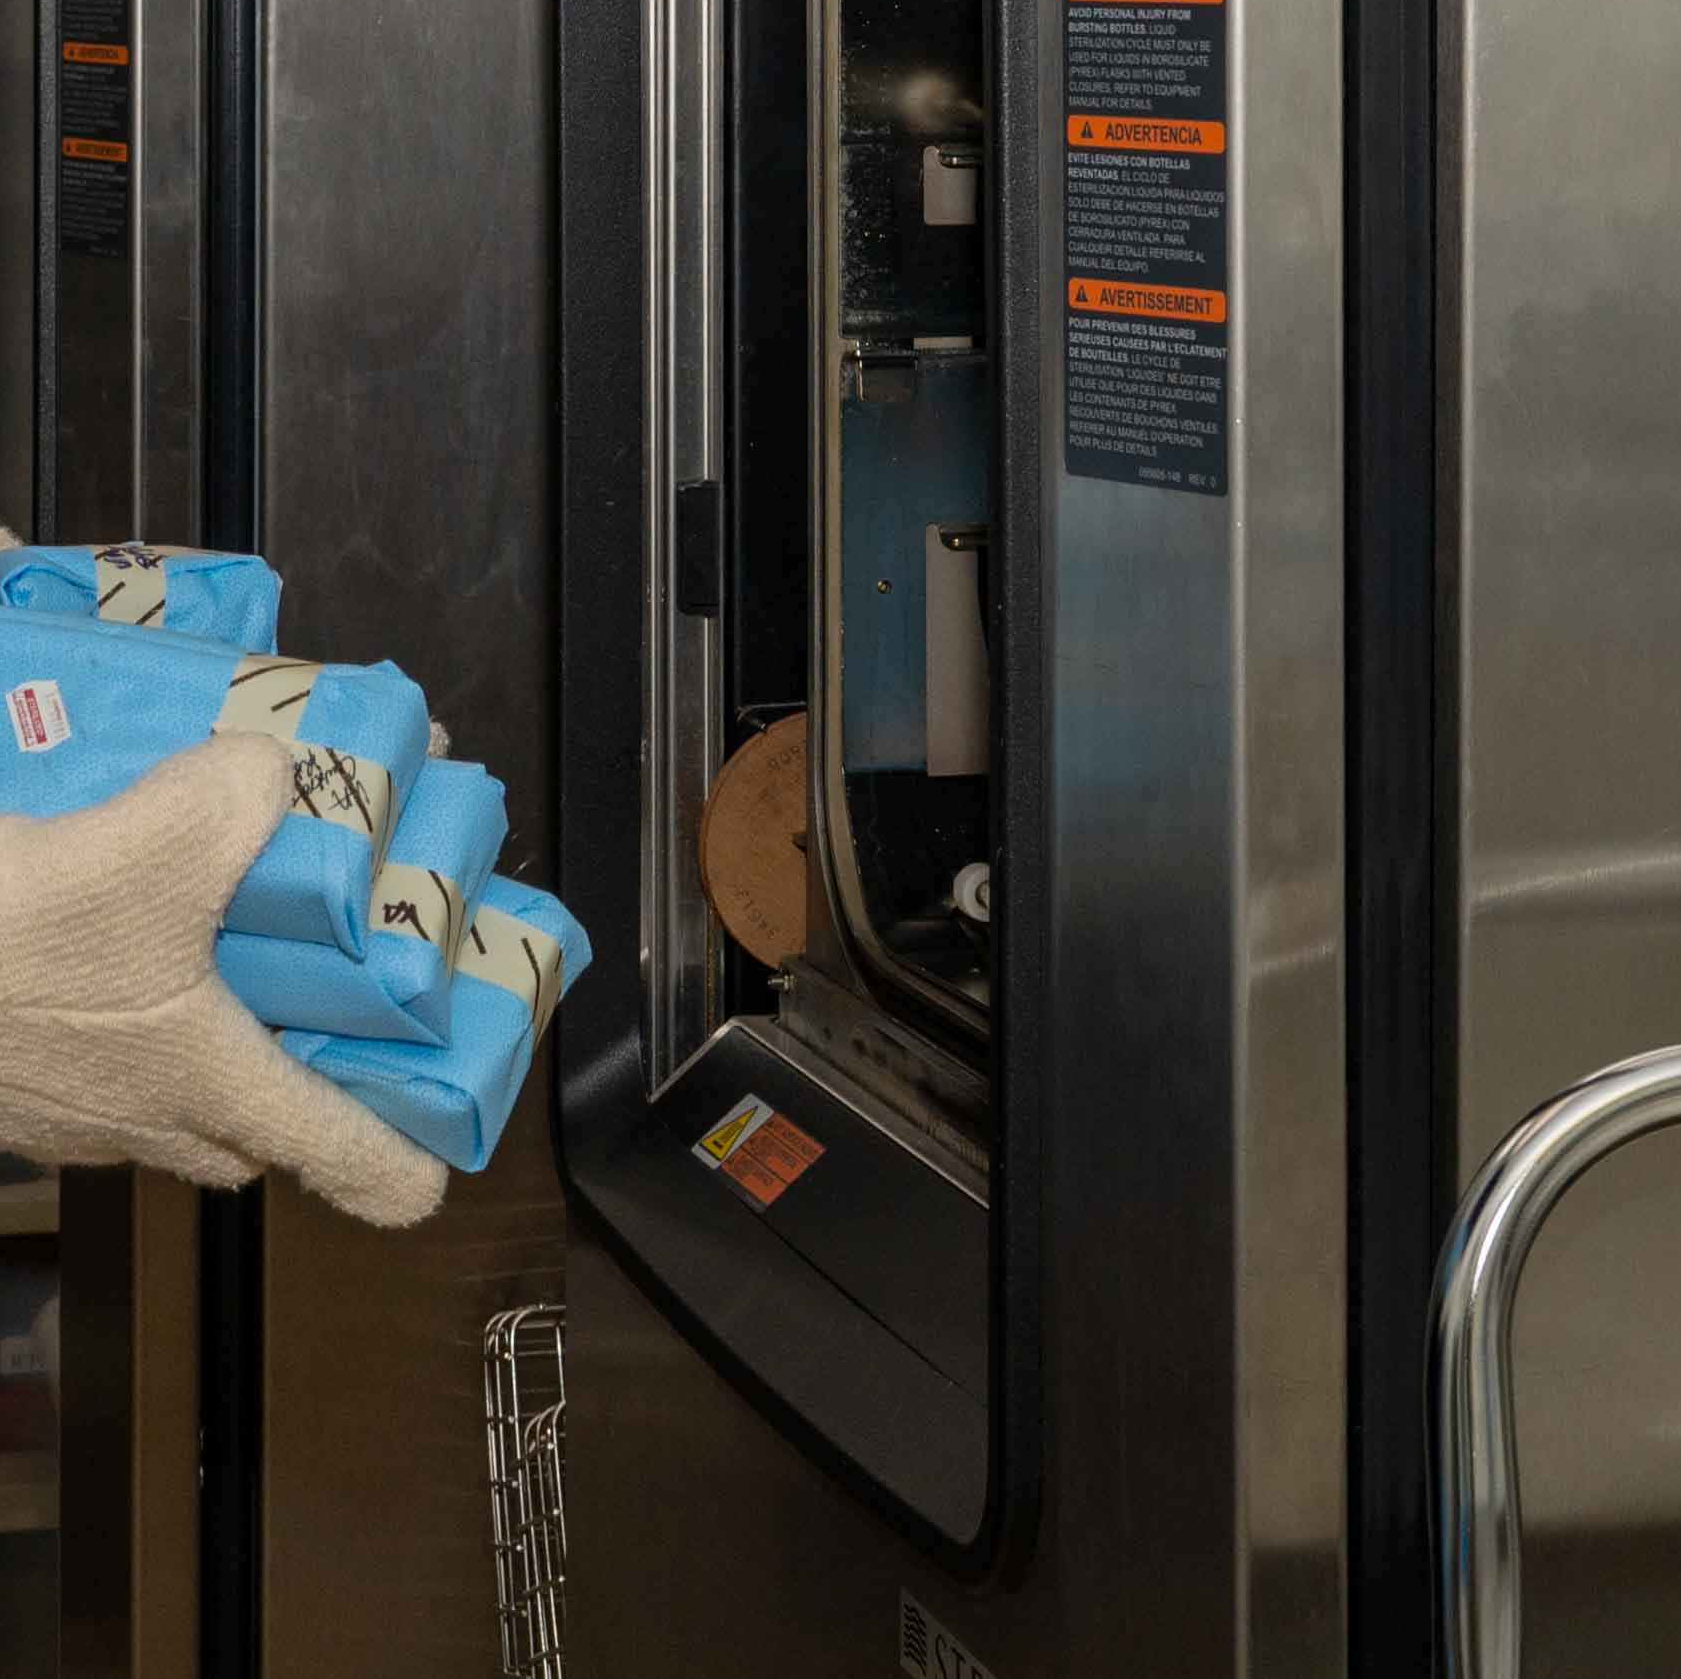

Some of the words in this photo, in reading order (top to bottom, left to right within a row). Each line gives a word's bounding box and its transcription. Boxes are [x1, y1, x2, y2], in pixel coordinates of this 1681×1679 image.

[1069, 8, 1092, 17] AVOID
[1094, 8, 1135, 19] PERSONAL
[1137, 9, 1165, 19] INJURY
[1167, 10, 1191, 20] FROM
[1069, 22, 1108, 33] BURSTING
[1150, 24, 1176, 35] LIQUID
[1104, 123, 1202, 145] ADVERTENCIA
[1068, 153, 1089, 163] EVITE
[1091, 153, 1128, 166] LESIONES
[1130, 155, 1147, 167] CON
[1149, 157, 1190, 170] BOTELLAS
[1099, 288, 1212, 315] AVERTISSEMENT
